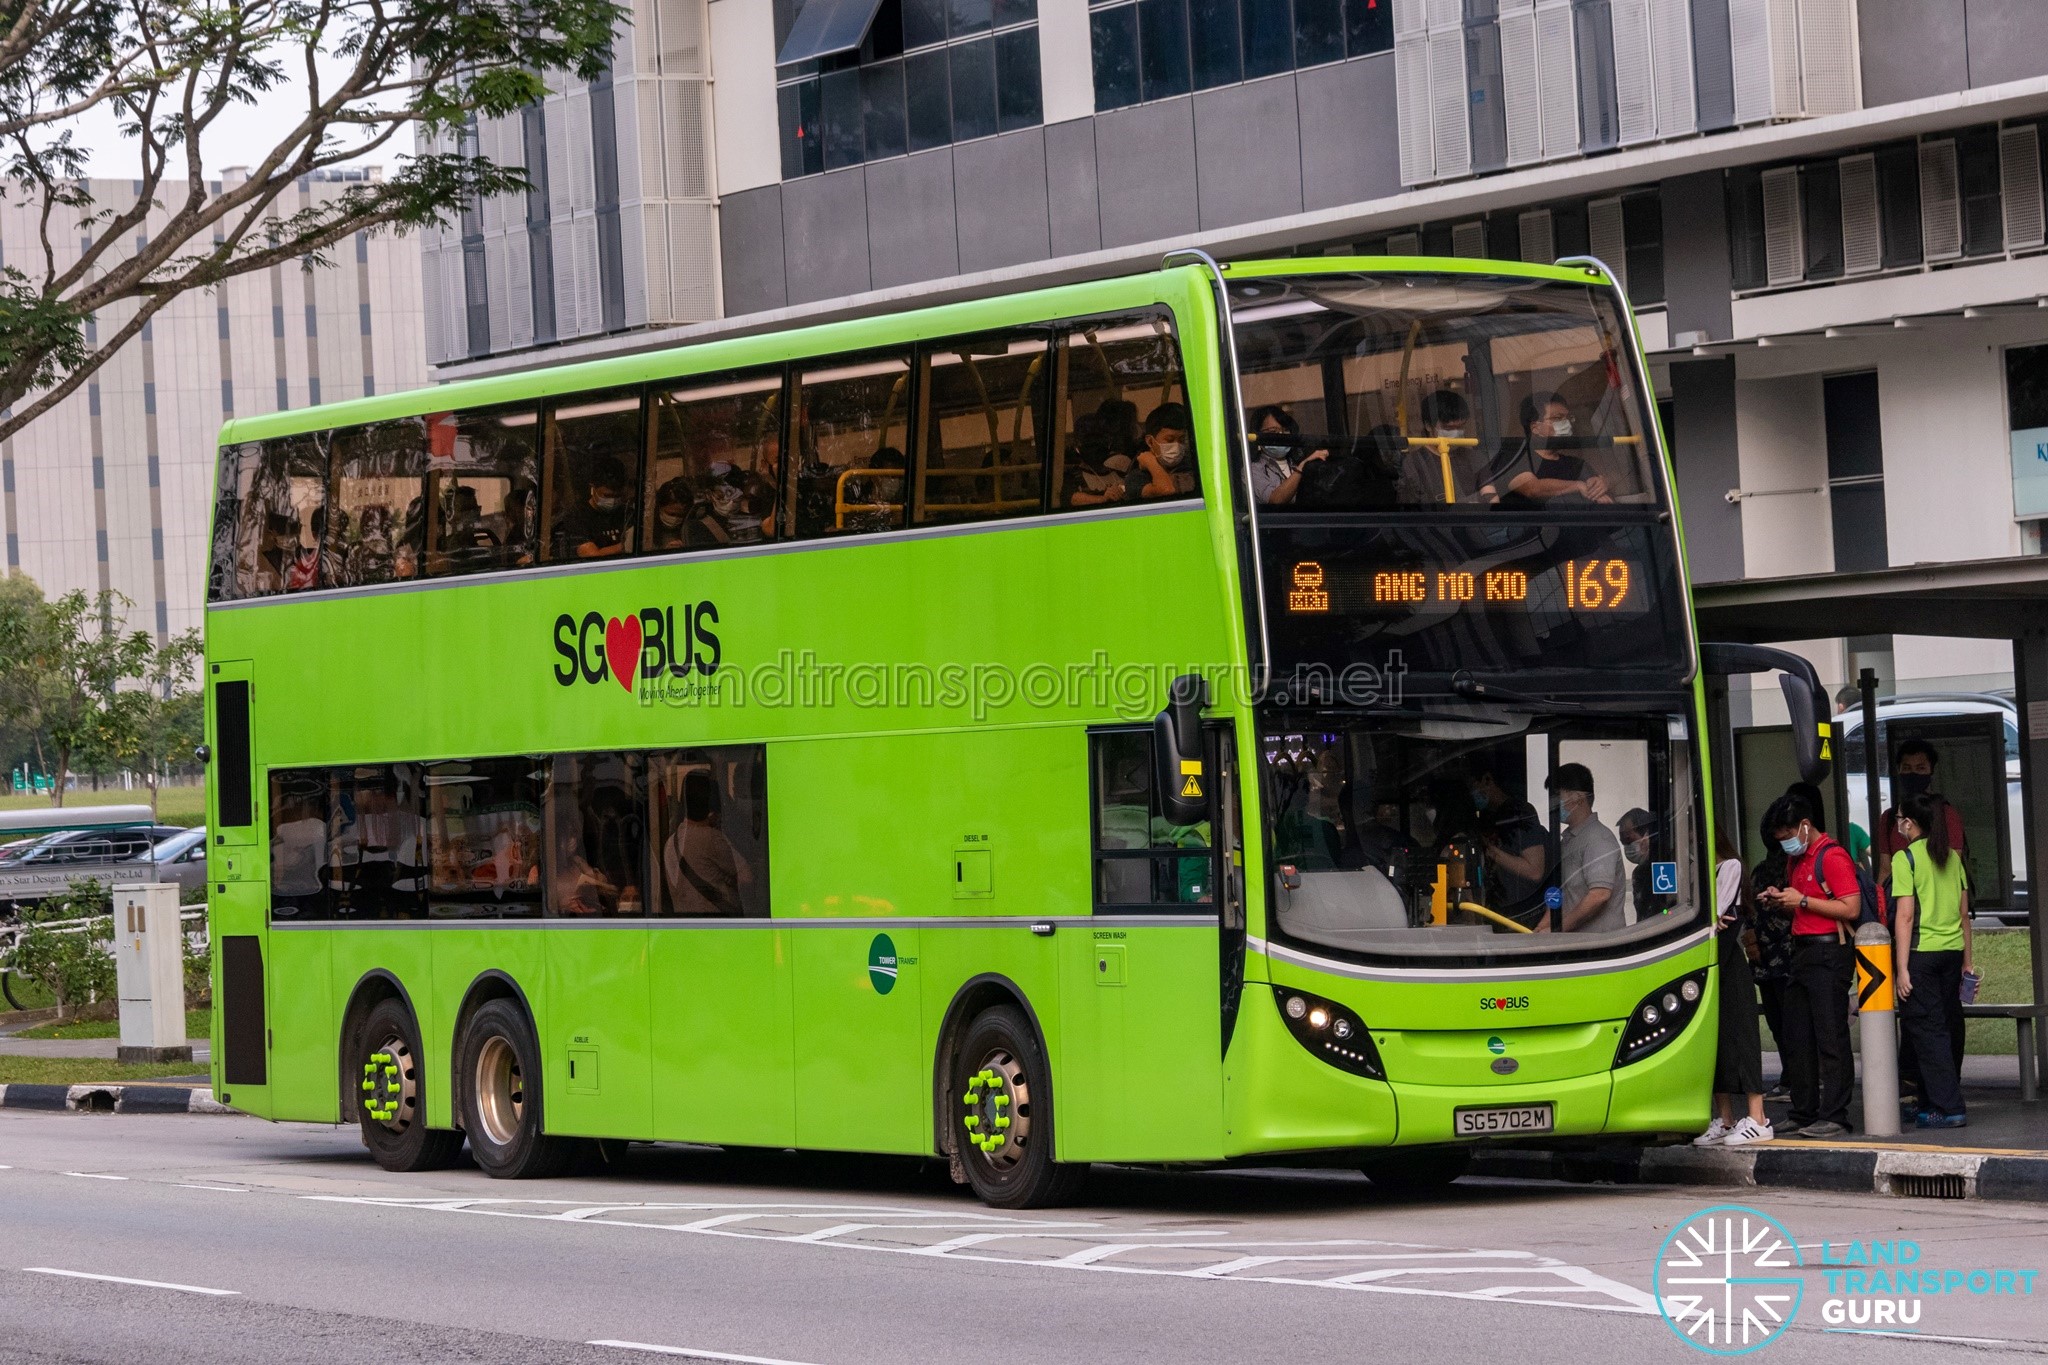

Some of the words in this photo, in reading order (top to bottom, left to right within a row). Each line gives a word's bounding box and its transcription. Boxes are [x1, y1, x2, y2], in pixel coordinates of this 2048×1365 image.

[1375, 572, 1425, 601] ANG
[1438, 572, 1474, 600] MO
[1486, 571, 1527, 600] KIO
[1567, 559, 1628, 608] 169
[640, 687, 664, 702] Moving
[666, 684, 688, 698] Ahead
[690, 682, 721, 699] Together
[14, 876, 30, 885] Star
[32, 874, 61, 885] Design
[1093, 931, 1111, 939] SCREEN
[1112, 931, 1127, 939] WASH
[879, 956, 896, 965] TOWER
[897, 956, 919, 965] TRANSIT
[1463, 1110, 1545, 1131] SG5702M
